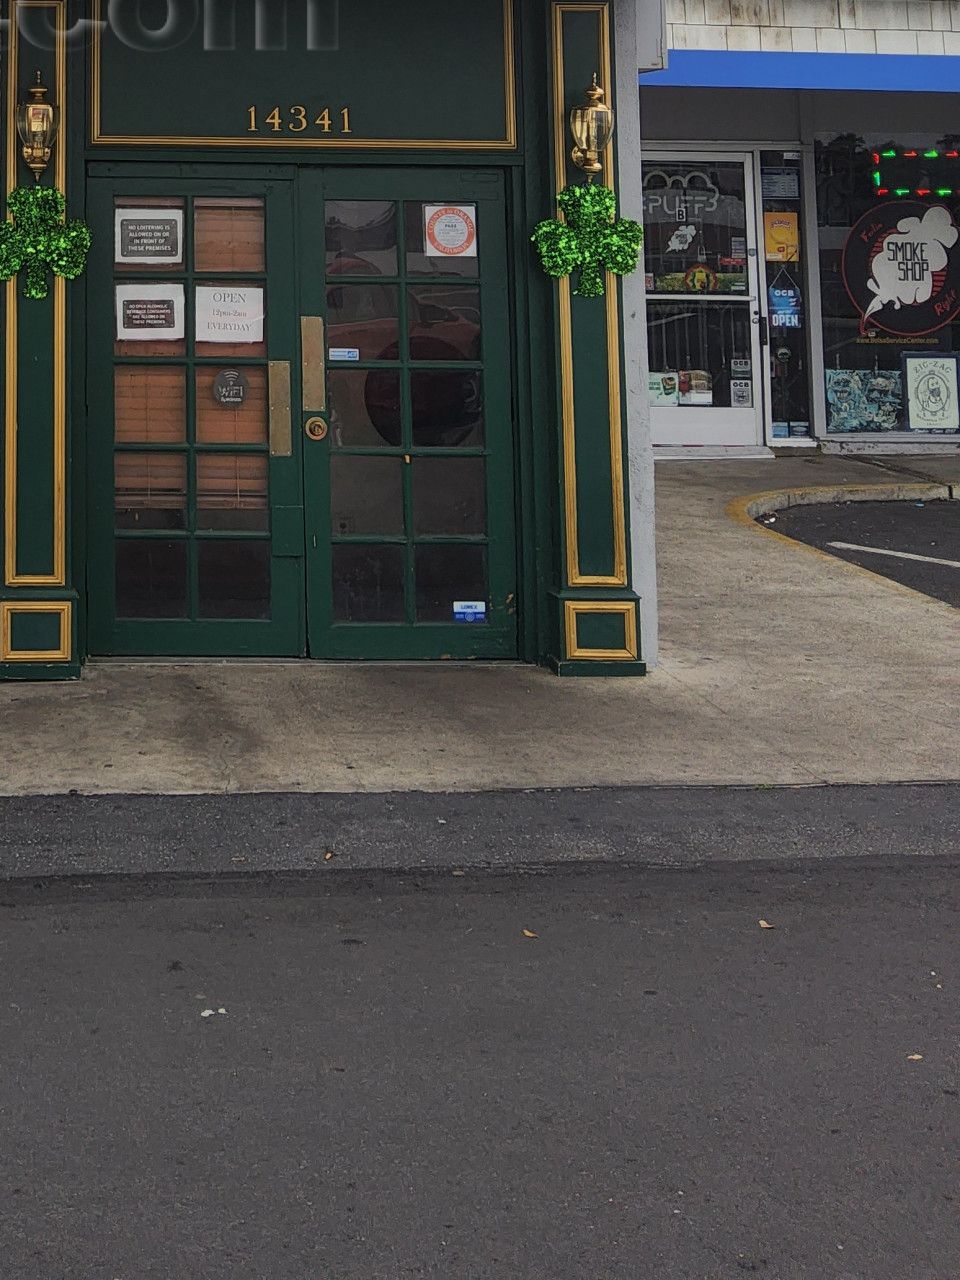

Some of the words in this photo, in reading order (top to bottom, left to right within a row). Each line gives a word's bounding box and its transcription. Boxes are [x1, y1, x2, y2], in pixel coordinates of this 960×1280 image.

[247, 106, 352, 133] 14341
[677, 209, 685, 220] B
[887, 241, 928, 262] SMOKE
[898, 261, 929, 282] SHOP
[212, 292, 247, 303] OPEN
[774, 289, 795, 297] OCB
[207, 322, 252, 331] EVERYDAY
[772, 314, 798, 327] OPEN
[913, 360, 952, 375] ZIG-ZAG
